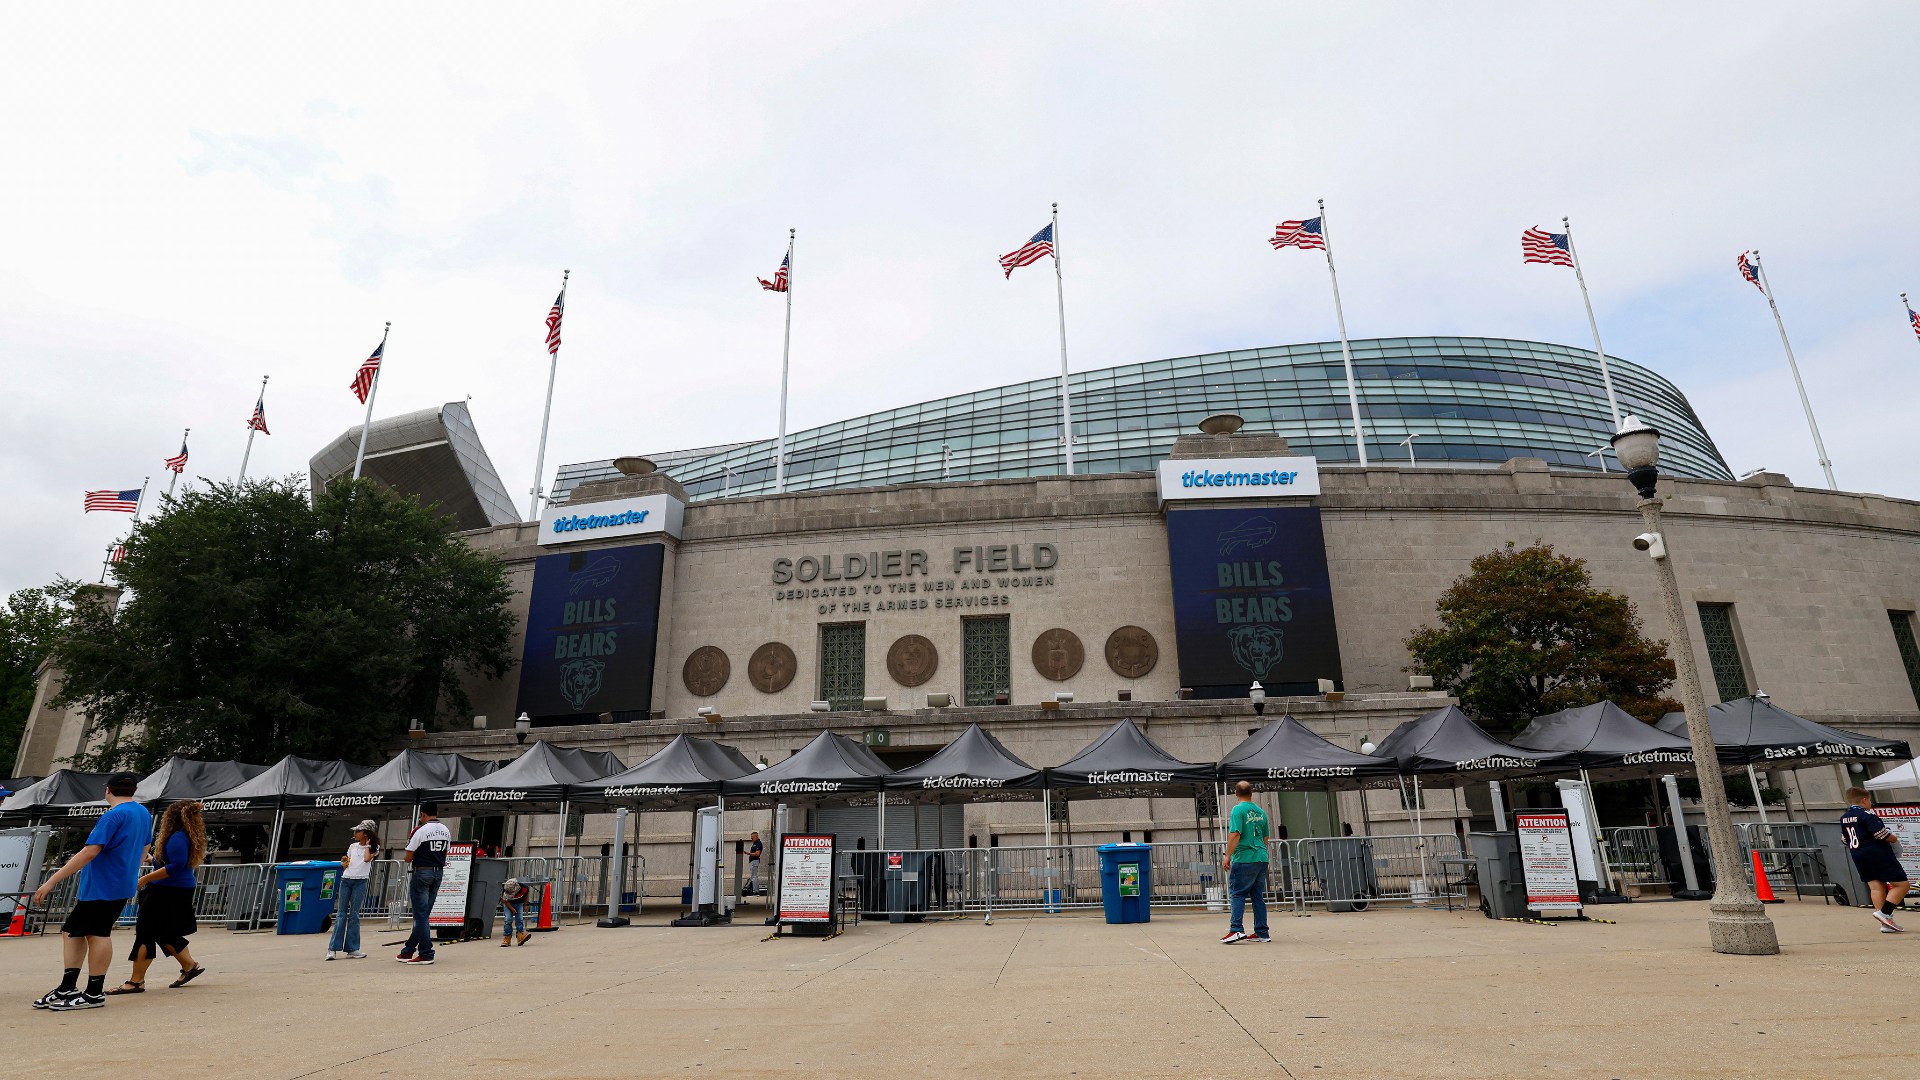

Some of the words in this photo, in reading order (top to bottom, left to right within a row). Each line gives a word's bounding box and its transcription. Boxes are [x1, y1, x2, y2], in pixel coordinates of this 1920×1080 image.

[1182, 469, 1297, 487] ticketmaster
[552, 508, 649, 533] ticketmaster
[771, 549, 928, 584] SOLDIER
[953, 543, 1058, 573] FIELD
[1217, 561, 1283, 587] BILLS
[776, 585, 856, 600] DEDICATED
[864, 584, 881, 595] TO
[889, 582, 916, 592] THE
[923, 580, 954, 591] MEN
[961, 578, 990, 589] AND
[997, 575, 1054, 587] WOMEN
[563, 598, 616, 625] BILLS
[818, 604, 836, 614] OF
[843, 601, 870, 612] THE
[876, 599, 928, 611] ARMED
[935, 595, 1009, 609] SERVICES
[1216, 597, 1292, 623] BEARS
[555, 631, 617, 659] BEARS
[1815, 742, 1853, 755] South
[1456, 755, 1540, 771] ticketmaster
[1623, 750, 1695, 764] ticketmast
[1088, 770, 1174, 784] ticketmaster
[1267, 765, 1356, 779] ticketmaster
[760, 780, 841, 794] ticketmaster
[922, 776, 1006, 789] ticketmaster
[453, 789, 527, 802] ticketmaster
[604, 784, 682, 798] ticketmaster
[201, 799, 251, 811] ketmaster
[315, 793, 383, 807] ticketmaster
[68, 805, 112, 816] ticketma
[1518, 818, 1567, 827] ATTENTION
[784, 838, 832, 847] ATTENTION
